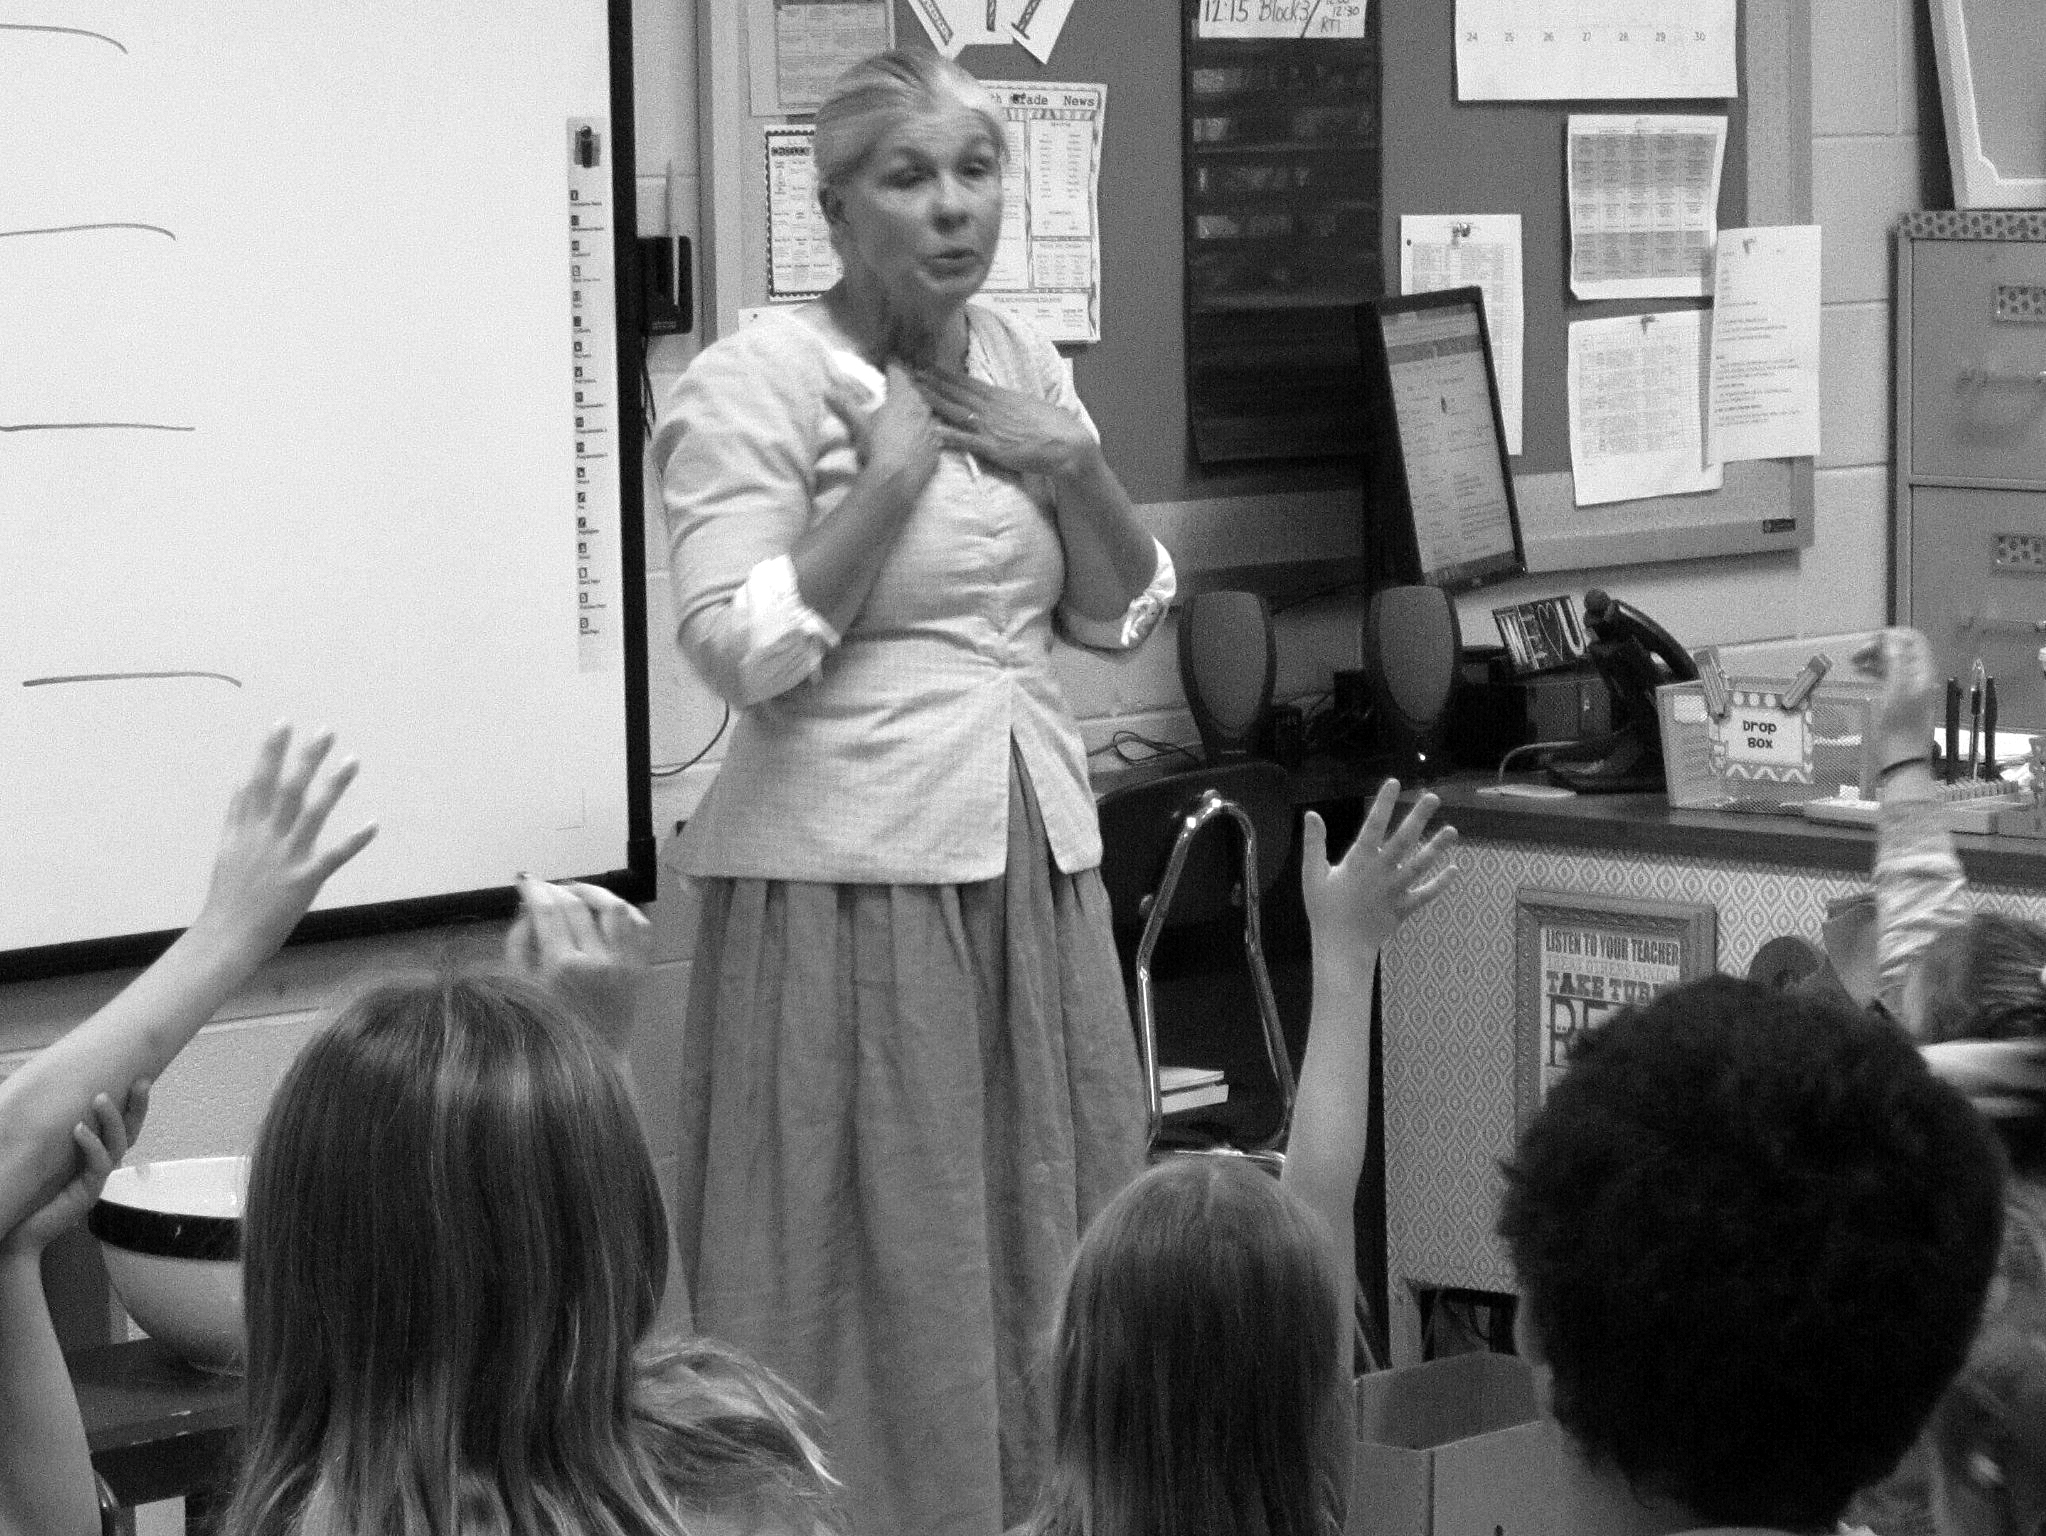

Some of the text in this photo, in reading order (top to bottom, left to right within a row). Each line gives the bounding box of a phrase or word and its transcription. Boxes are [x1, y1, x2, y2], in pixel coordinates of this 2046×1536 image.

[1204, 0, 1249, 22] 12:15
[1320, 16, 1341, 33] RTI
[1466, 31, 1706, 43] 24 25 26 27 28 29 30
[1064, 95, 1095, 106] News
[1743, 720, 1777, 735] Drop
[1546, 929, 1679, 966] LISTEN TO YOUR TEACHER
[1546, 970, 1605, 998] TAKE
